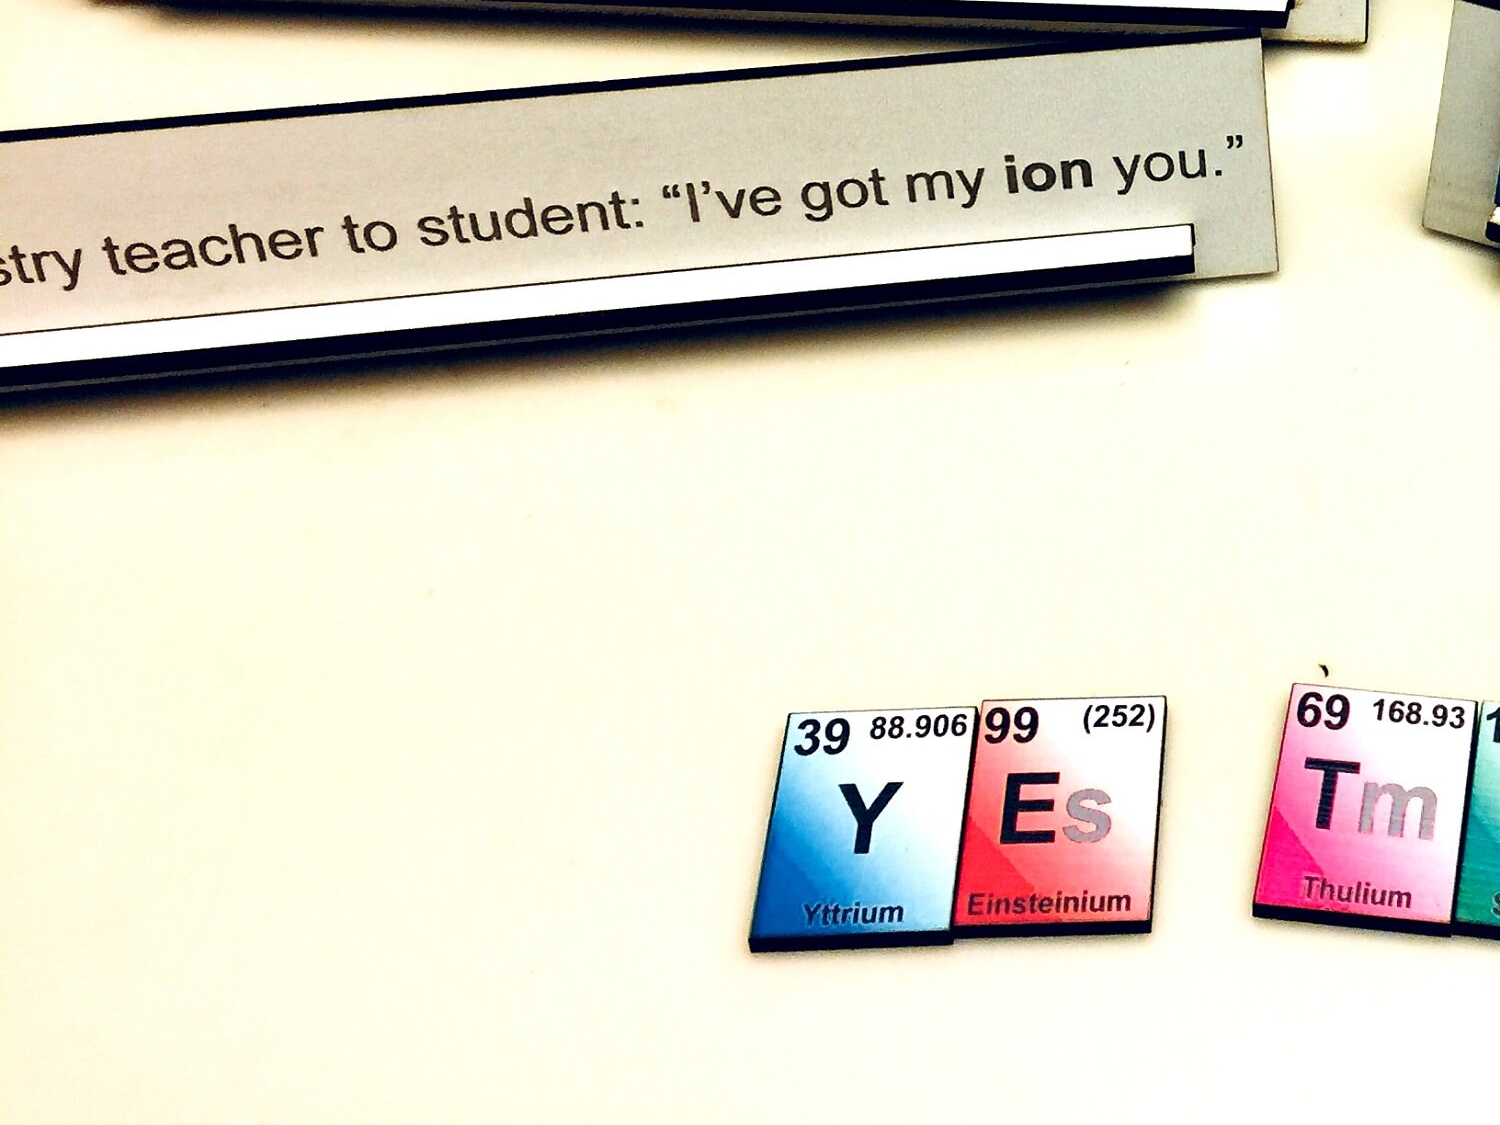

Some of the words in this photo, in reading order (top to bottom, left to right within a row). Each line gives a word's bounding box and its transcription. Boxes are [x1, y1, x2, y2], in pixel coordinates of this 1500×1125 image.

[102, 221, 324, 276] teacher
[342, 215, 398, 253] to
[418, 192, 645, 247] student:
[662, 183, 782, 222] “I’ve
[801, 168, 888, 222] got
[907, 166, 985, 209] my
[1005, 155, 1093, 194] ion
[1113, 135, 1244, 184] you.”
[983, 708, 1039, 744] 99
[1082, 703, 1157, 735] (252)
[1296, 692, 1351, 731] 69
[1372, 699, 1467, 730] 168.93
[794, 718, 850, 758] 39
[870, 712, 968, 741] 88.906
[839, 782, 904, 856] Y
[999, 771, 1113, 846] Es
[1304, 756, 1438, 842] Tm
[967, 888, 1132, 919] Einsteinium
[1303, 875, 1412, 909] Thulium
[802, 901, 905, 927] Yttrium
